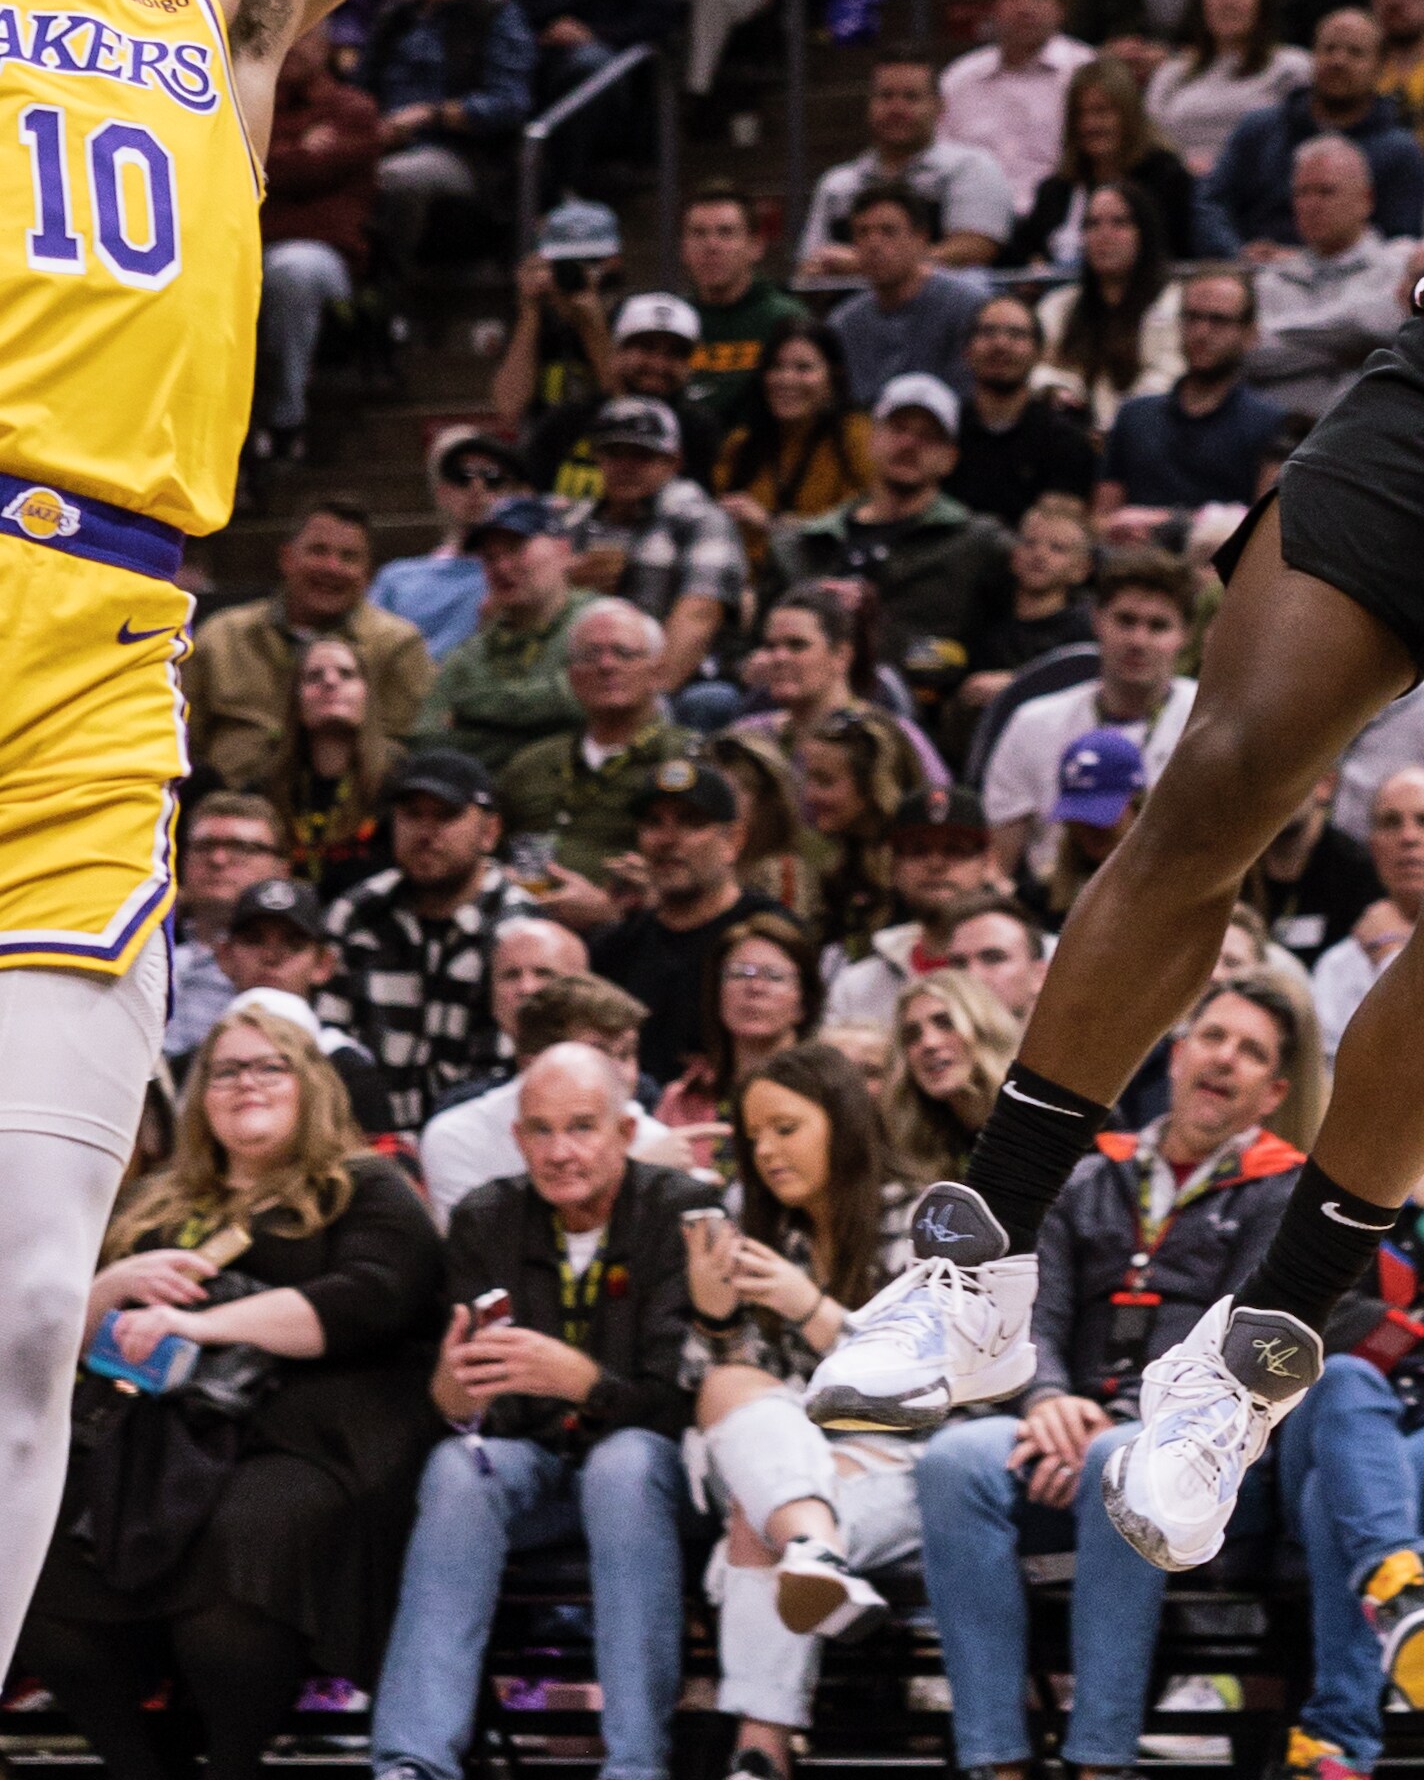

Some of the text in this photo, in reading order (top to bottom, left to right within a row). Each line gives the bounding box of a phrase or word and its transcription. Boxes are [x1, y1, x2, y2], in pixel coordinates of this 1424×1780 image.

[0, 7, 219, 114] AKERS
[18, 101, 183, 293] 10
[687, 340, 764, 372] AZZ
